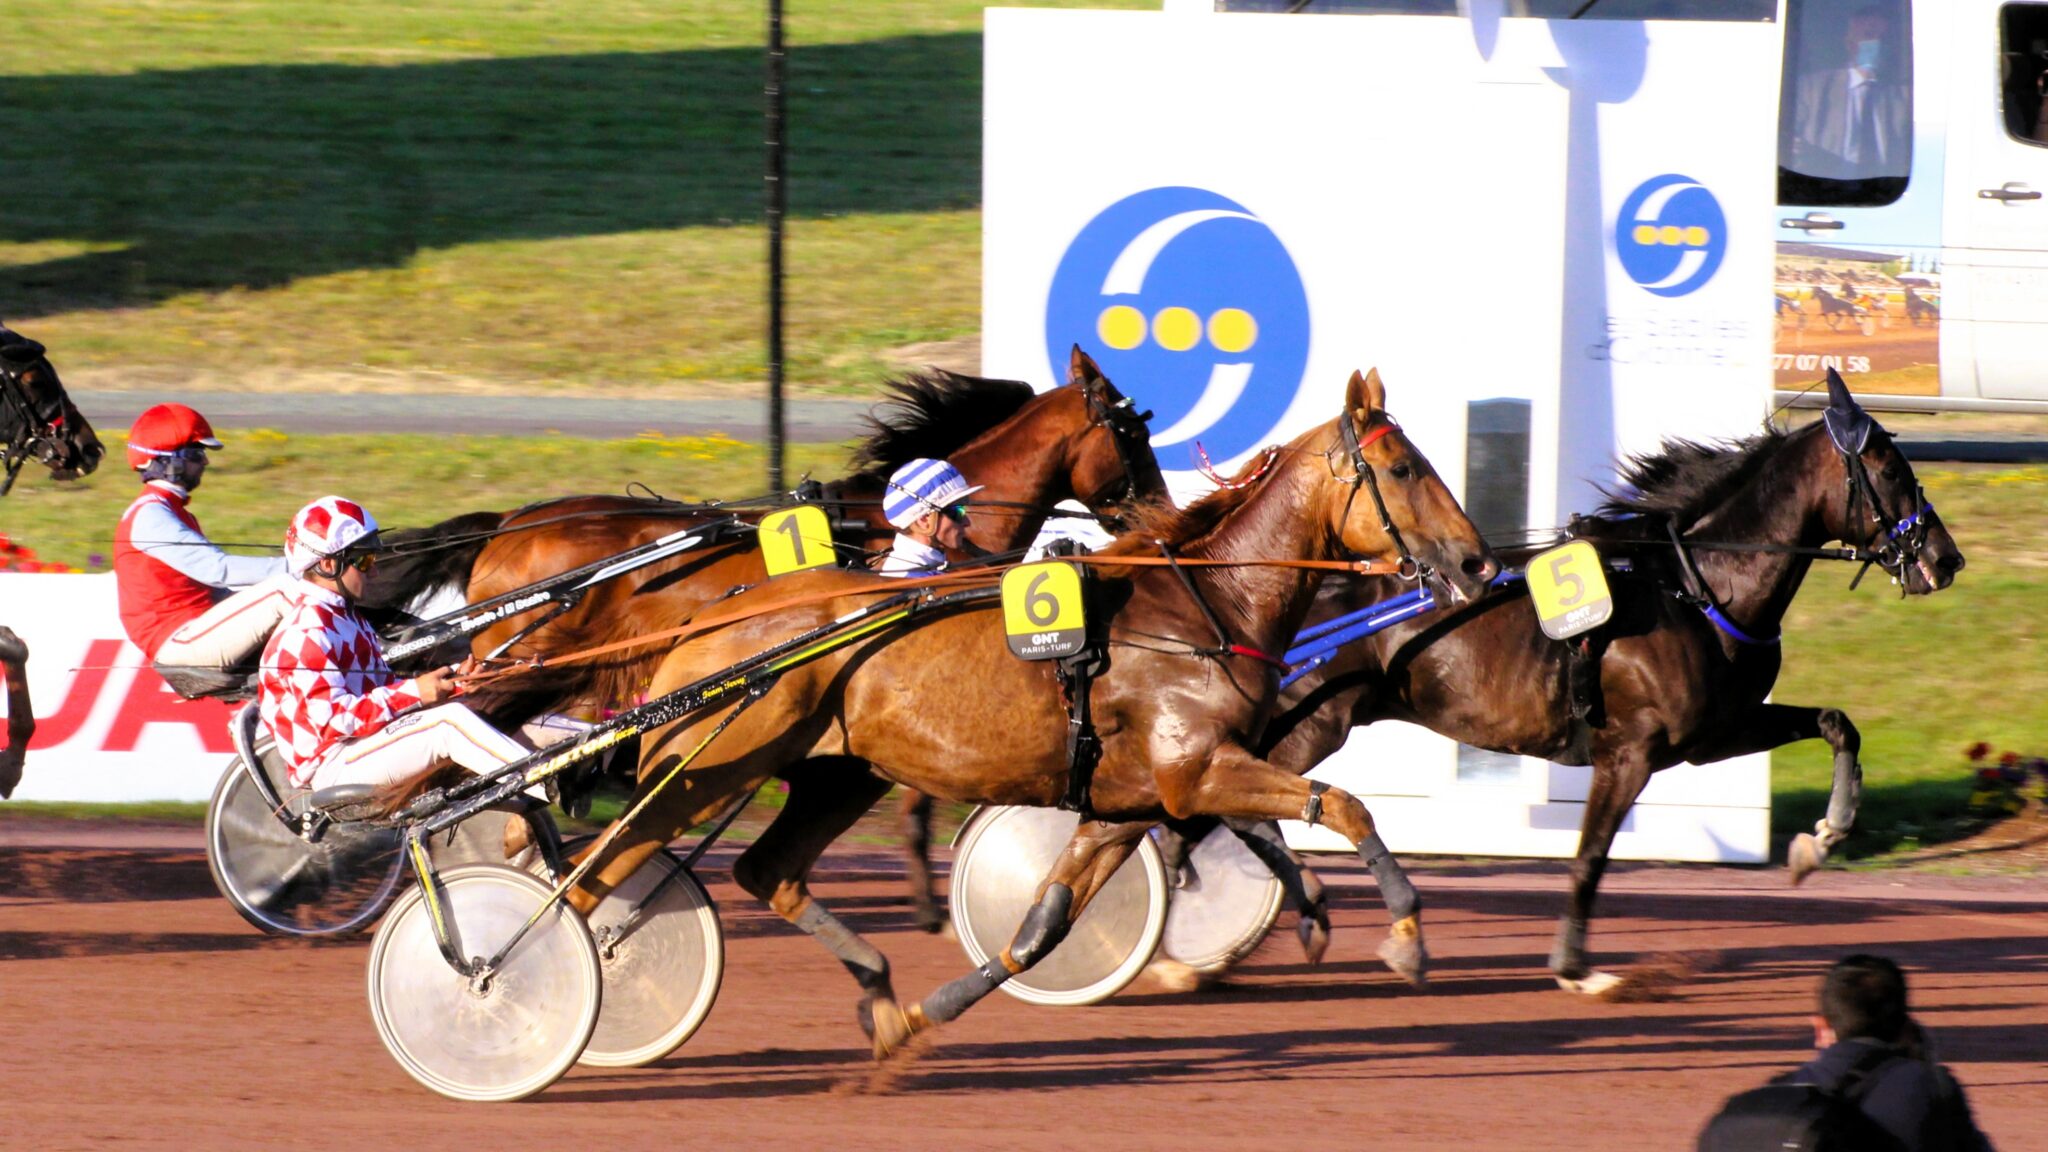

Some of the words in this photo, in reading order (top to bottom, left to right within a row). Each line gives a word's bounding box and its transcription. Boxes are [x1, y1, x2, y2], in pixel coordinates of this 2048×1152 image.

[1795, 354, 1820, 371] 07
[1821, 354, 1843, 372] 01
[1847, 356, 1871, 373] 58
[777, 514, 807, 566] 1
[1549, 553, 1585, 606] 5
[1024, 569, 1060, 627] 6
[1021, 642, 1072, 654] PARIS-TURF
[1031, 632, 1060, 644] GNT
